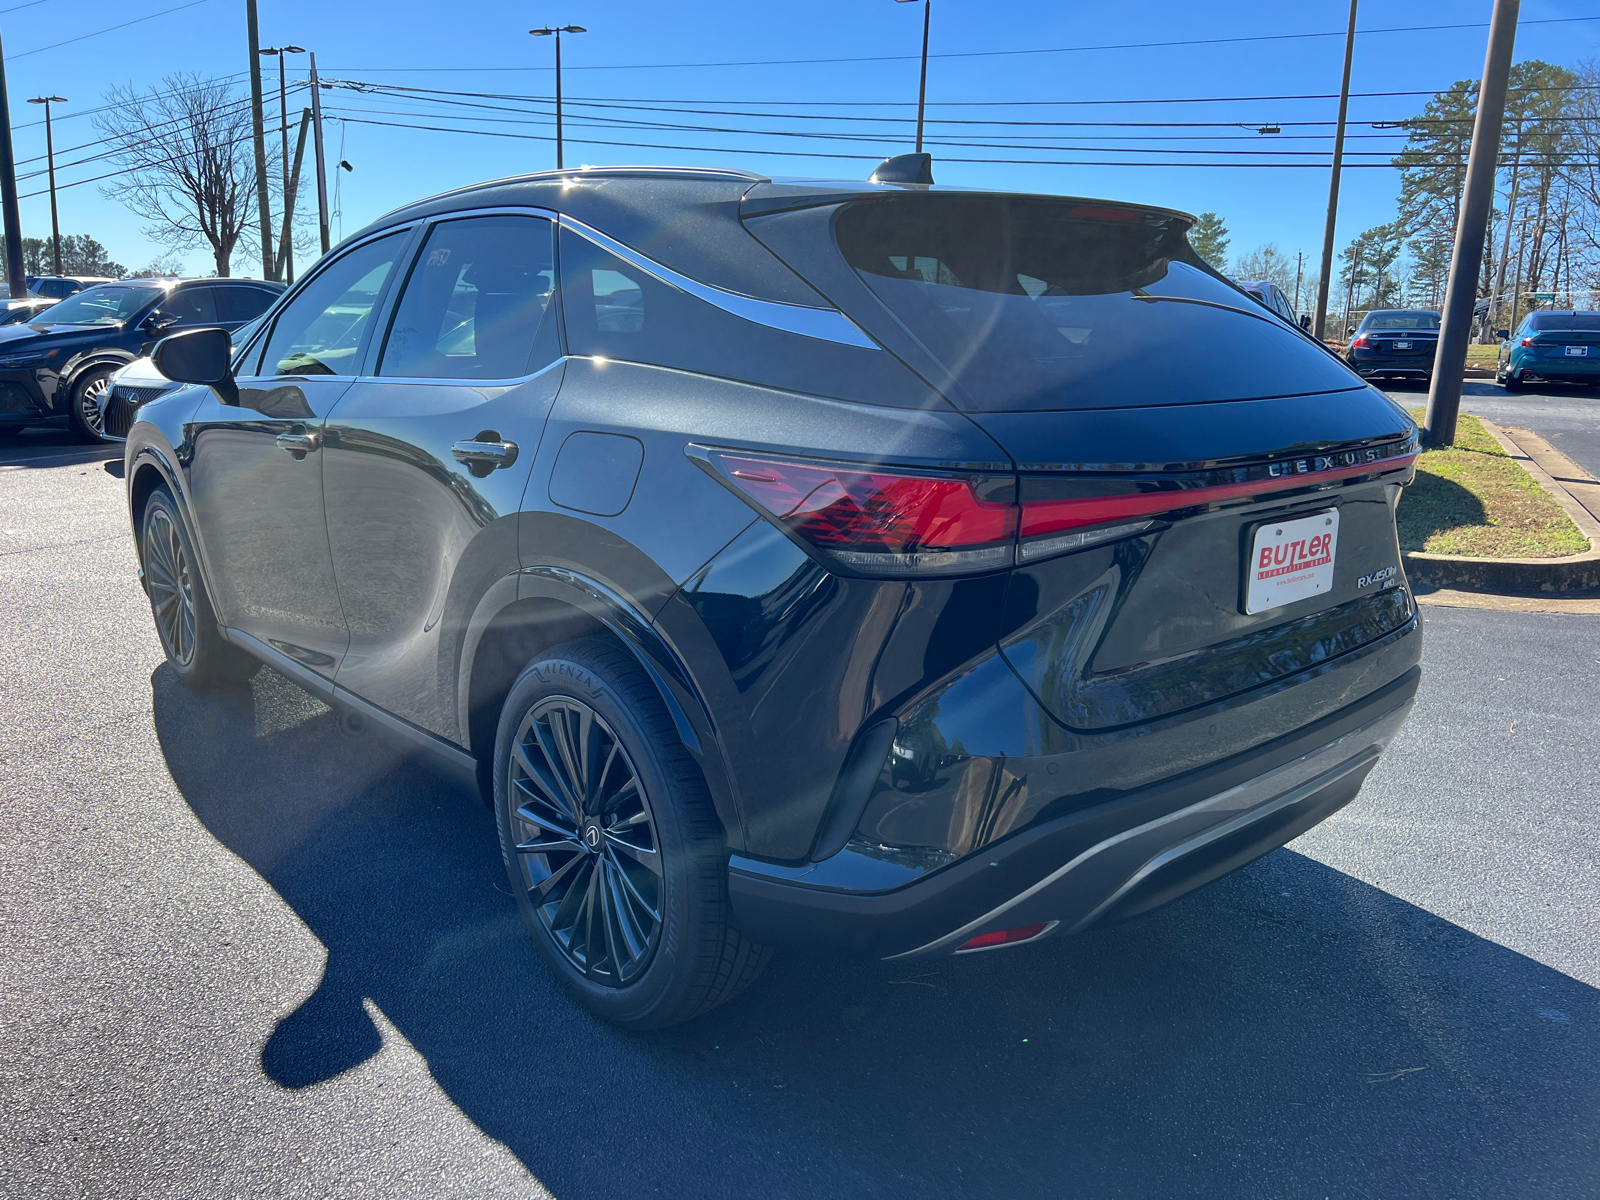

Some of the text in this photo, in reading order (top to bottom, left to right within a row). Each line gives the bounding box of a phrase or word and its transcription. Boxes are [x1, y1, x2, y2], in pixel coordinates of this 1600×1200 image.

[1268, 450, 1375, 477] LEXUS
[1310, 556, 1332, 567] GROUP
[544, 663, 592, 688] ALENZA
